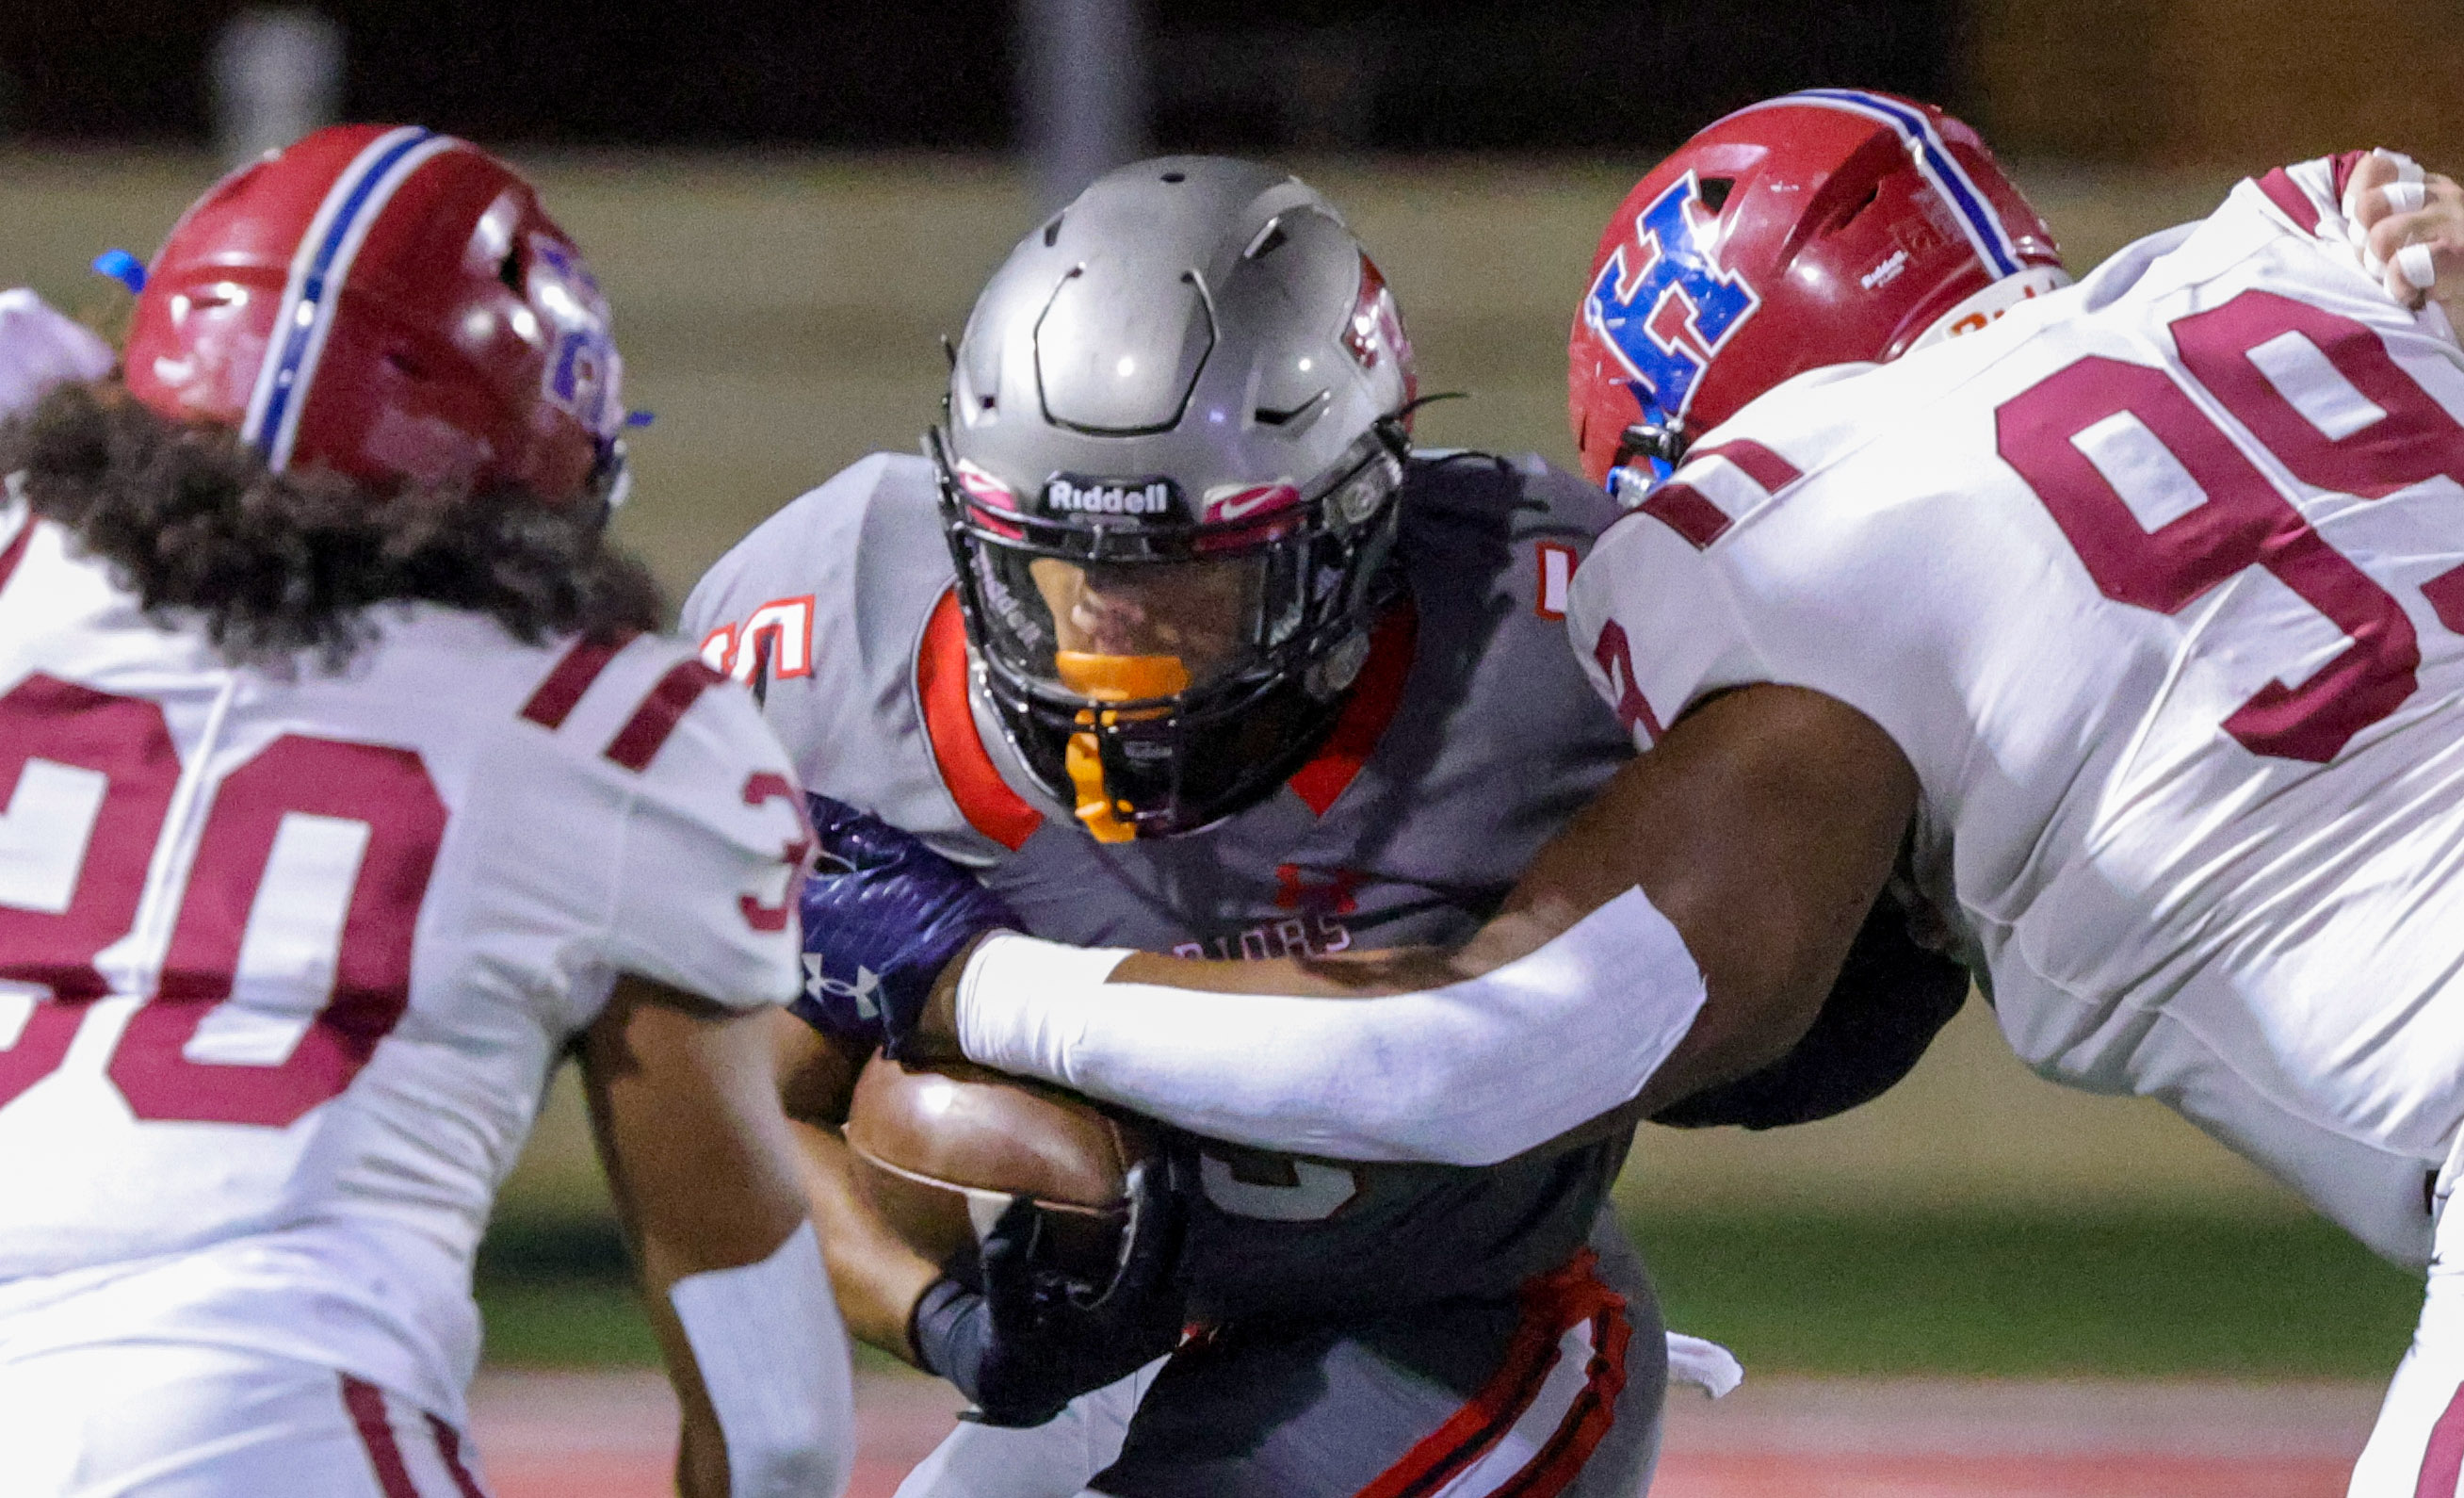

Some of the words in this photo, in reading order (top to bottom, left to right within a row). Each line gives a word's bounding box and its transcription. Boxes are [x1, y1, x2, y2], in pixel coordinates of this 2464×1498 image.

[1584, 168, 1761, 429] H
[1048, 480, 1167, 513] Riddell
[1994, 288, 2463, 764] 99
